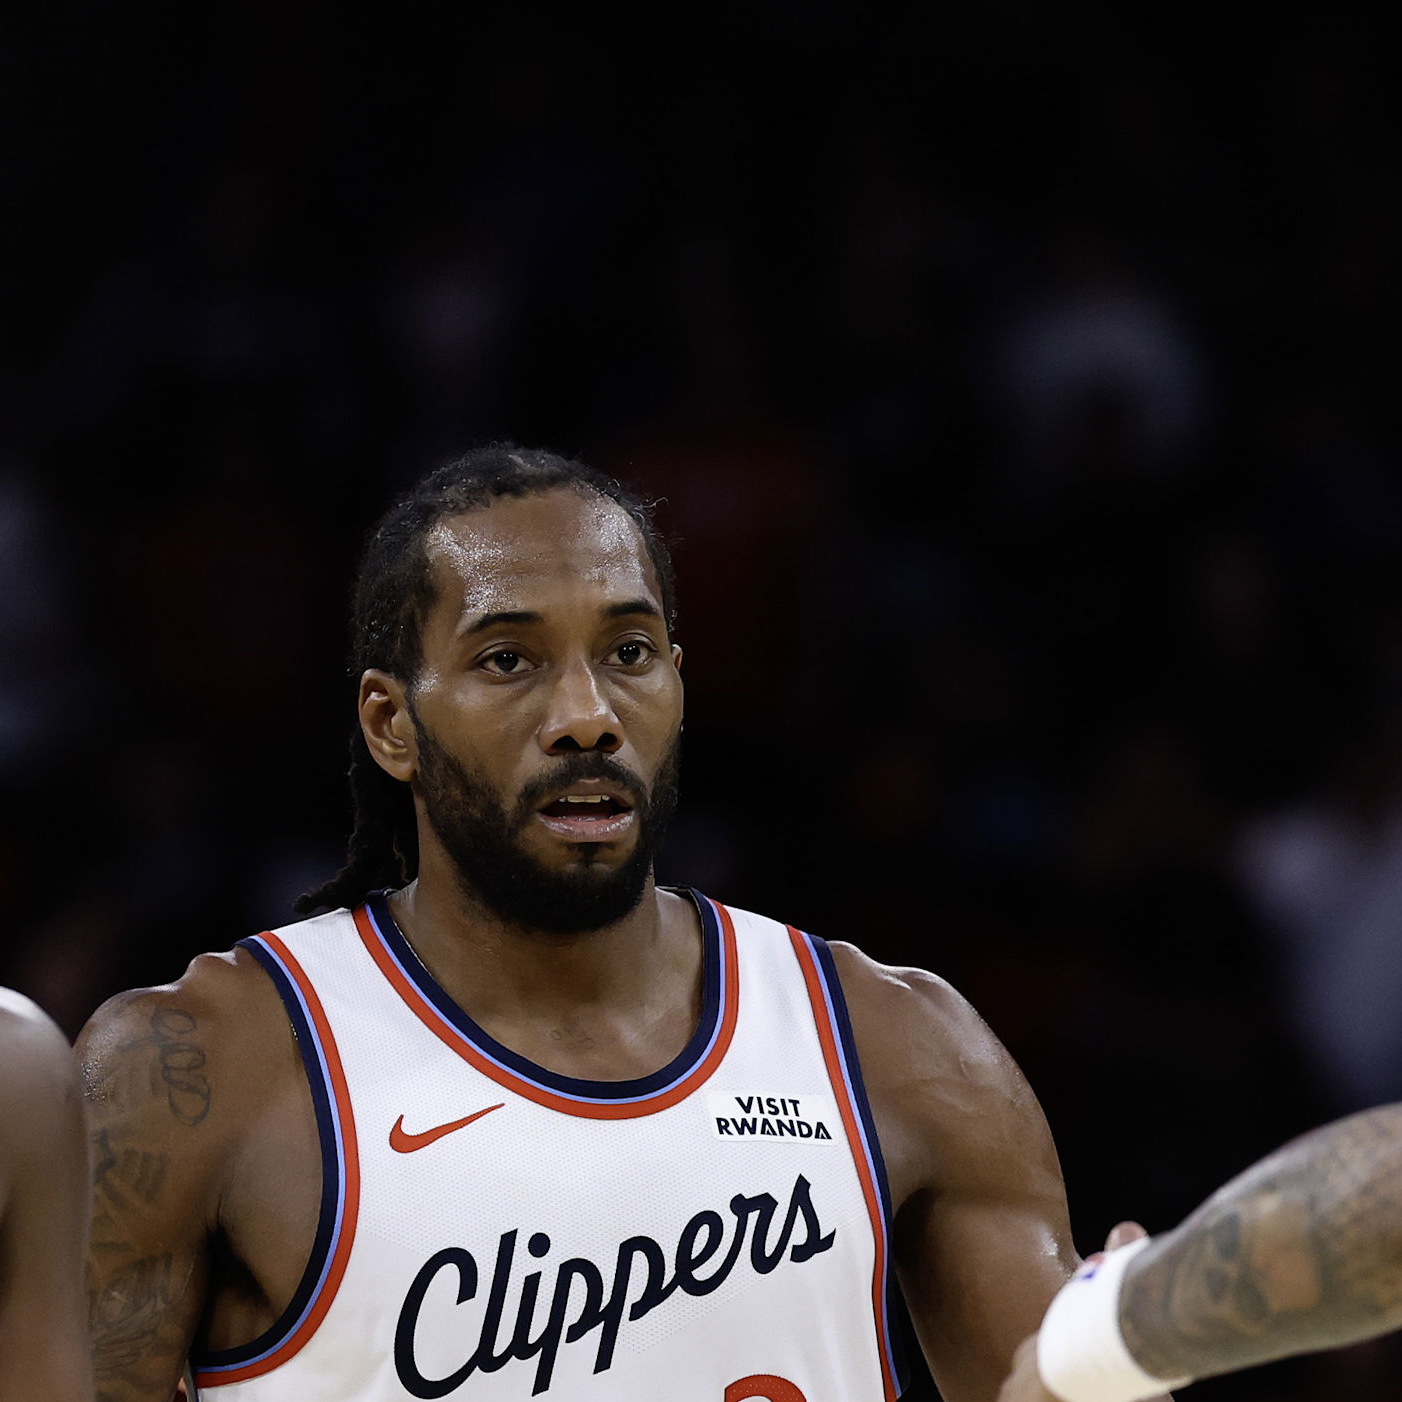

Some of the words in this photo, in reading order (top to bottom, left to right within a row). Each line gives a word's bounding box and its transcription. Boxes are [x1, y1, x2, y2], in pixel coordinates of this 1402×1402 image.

[734, 1096, 801, 1117] VISIT
[715, 1117, 833, 1140] RWANDA
[393, 1173, 837, 1400] Clippers
